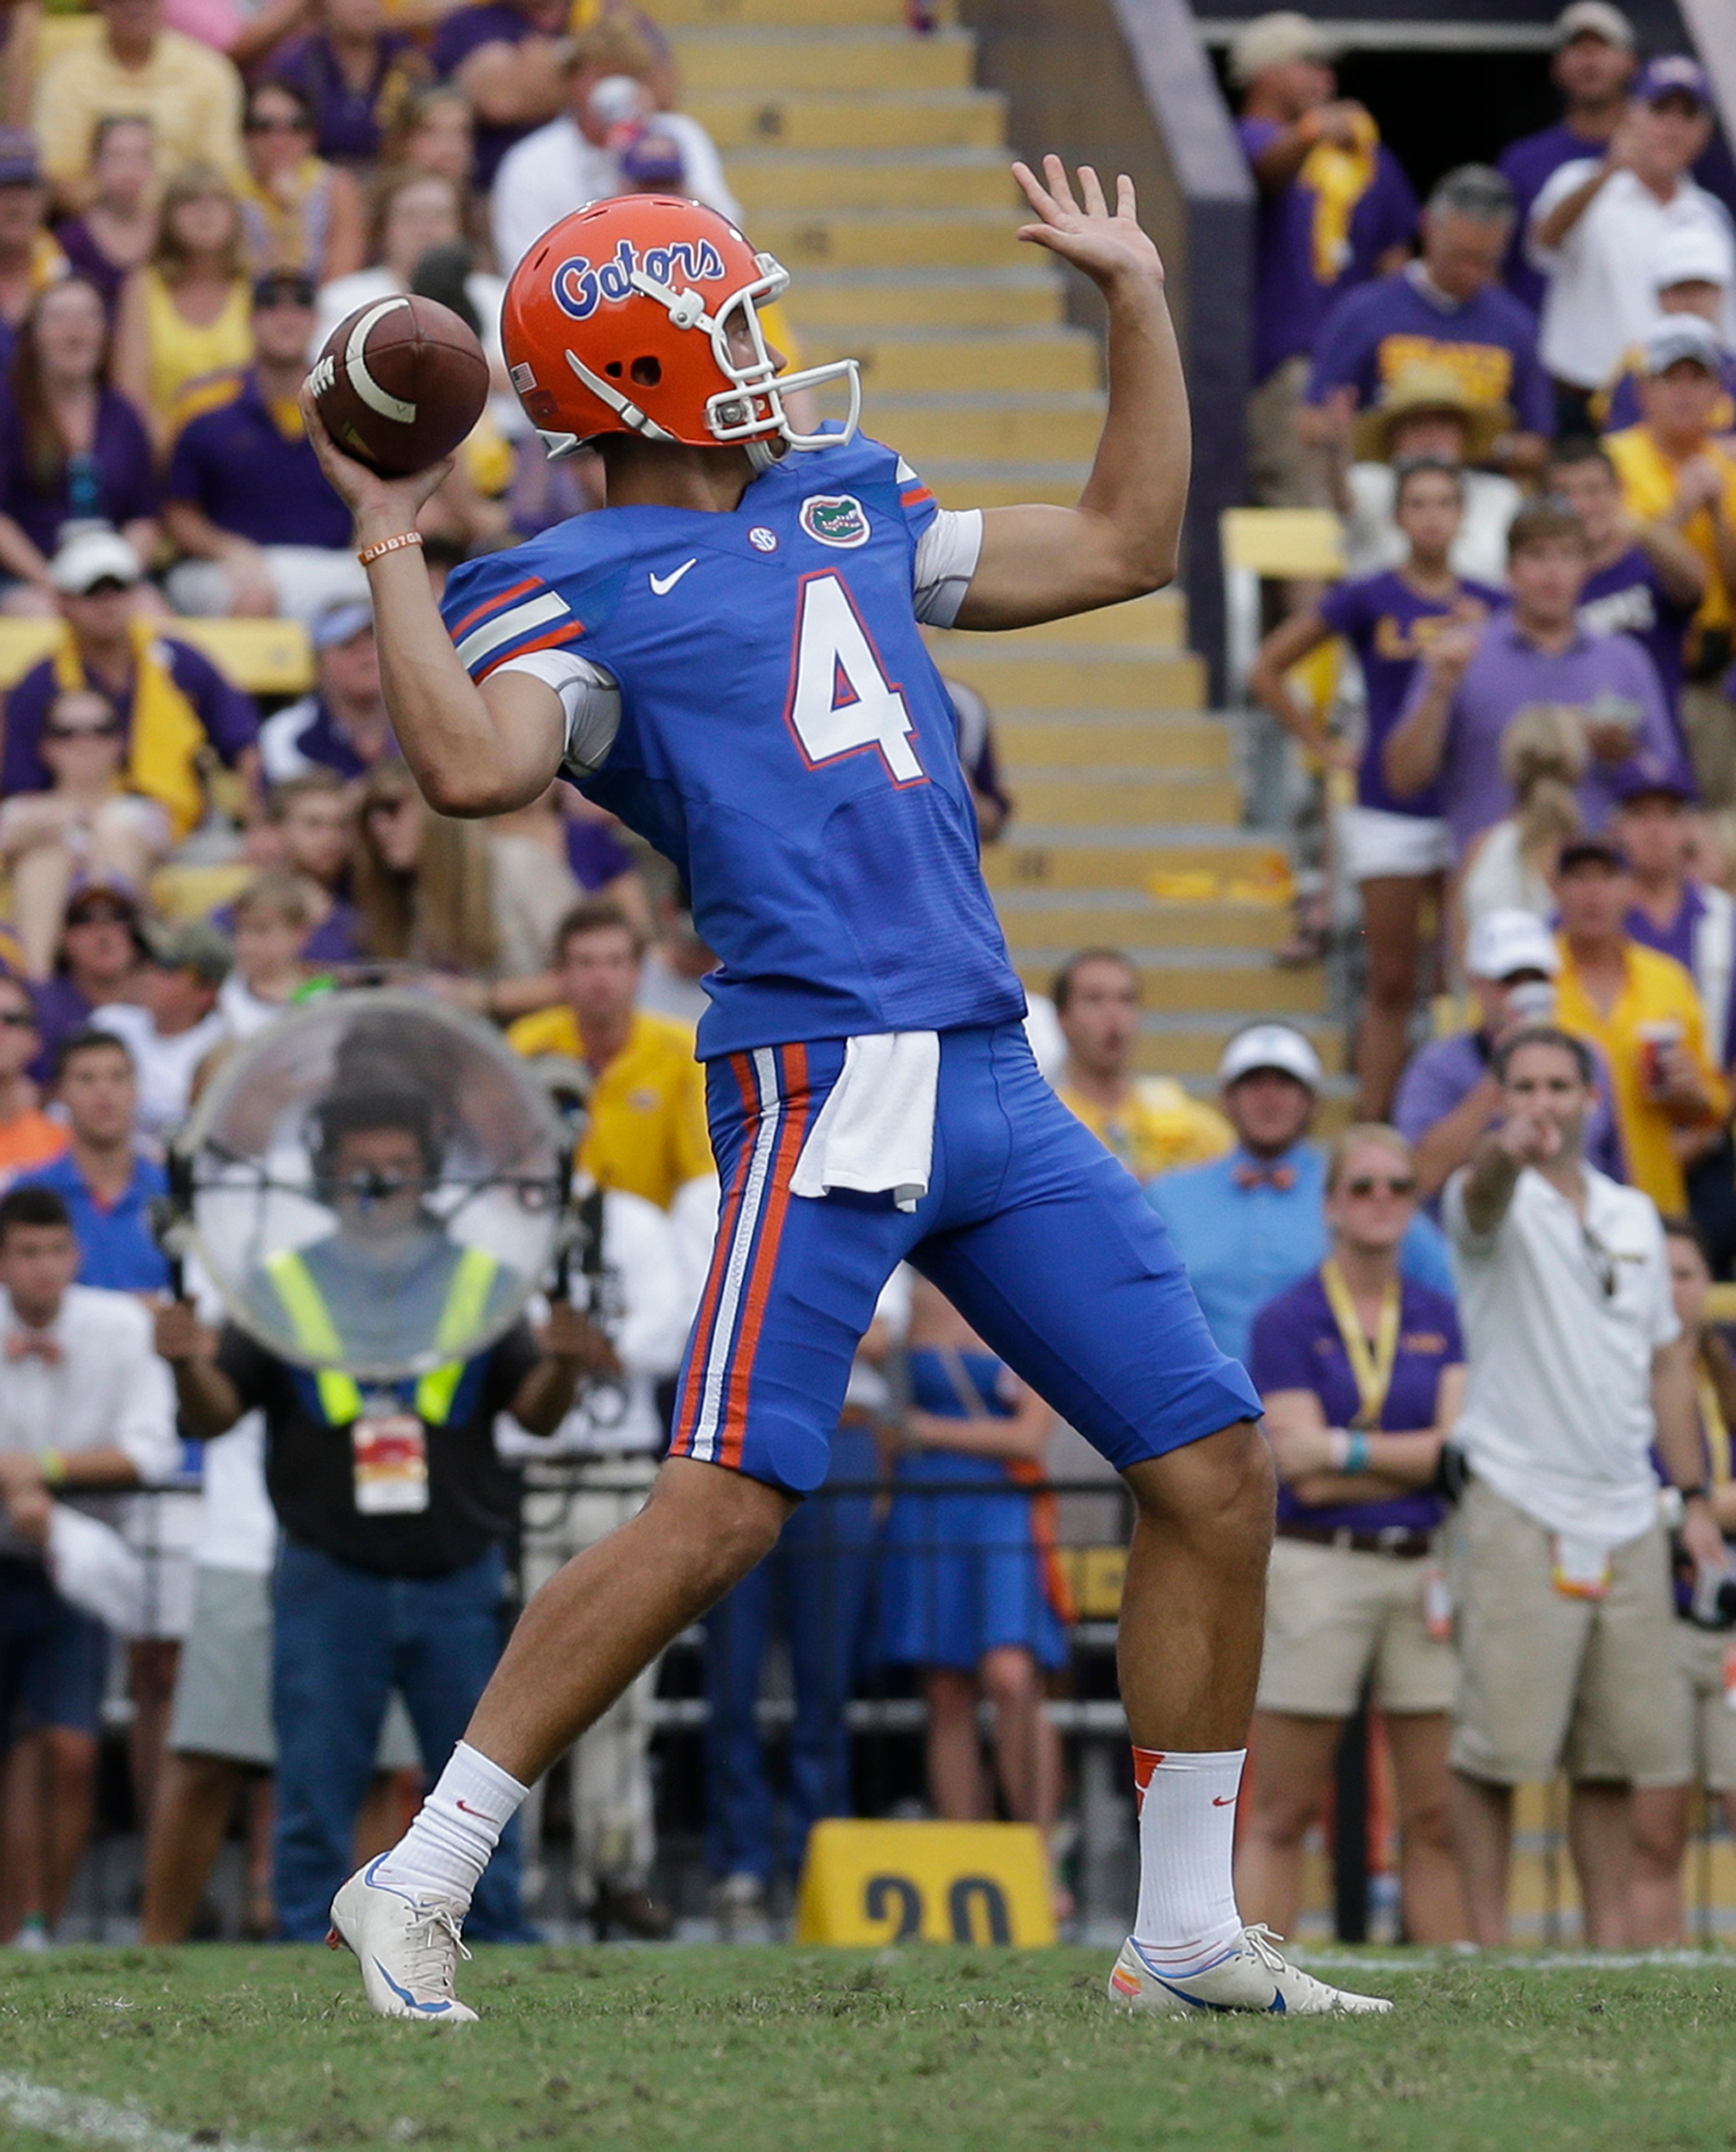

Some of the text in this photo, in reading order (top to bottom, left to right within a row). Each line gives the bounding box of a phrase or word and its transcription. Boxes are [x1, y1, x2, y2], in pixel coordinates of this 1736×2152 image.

[552, 239, 725, 320] Gators
[783, 567, 931, 790] 4
[866, 1876, 1010, 1946] 20
